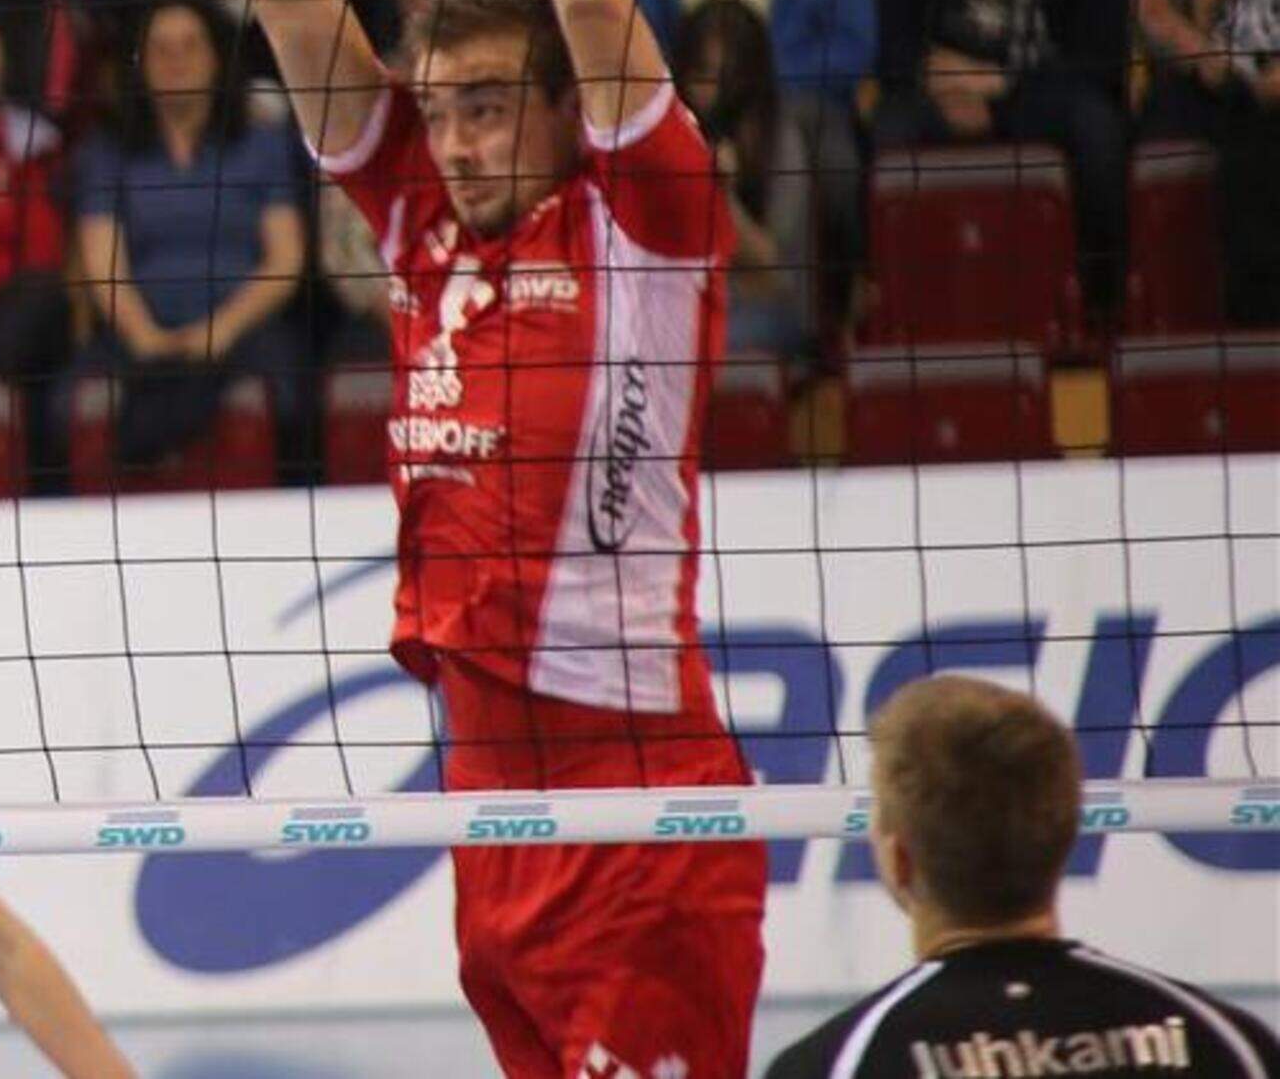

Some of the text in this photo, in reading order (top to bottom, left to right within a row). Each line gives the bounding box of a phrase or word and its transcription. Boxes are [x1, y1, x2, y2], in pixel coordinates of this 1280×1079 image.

[96, 825, 185, 847] SWD
[282, 821, 370, 843] SWD
[467, 818, 558, 840] SWD
[654, 814, 746, 836] SWD
